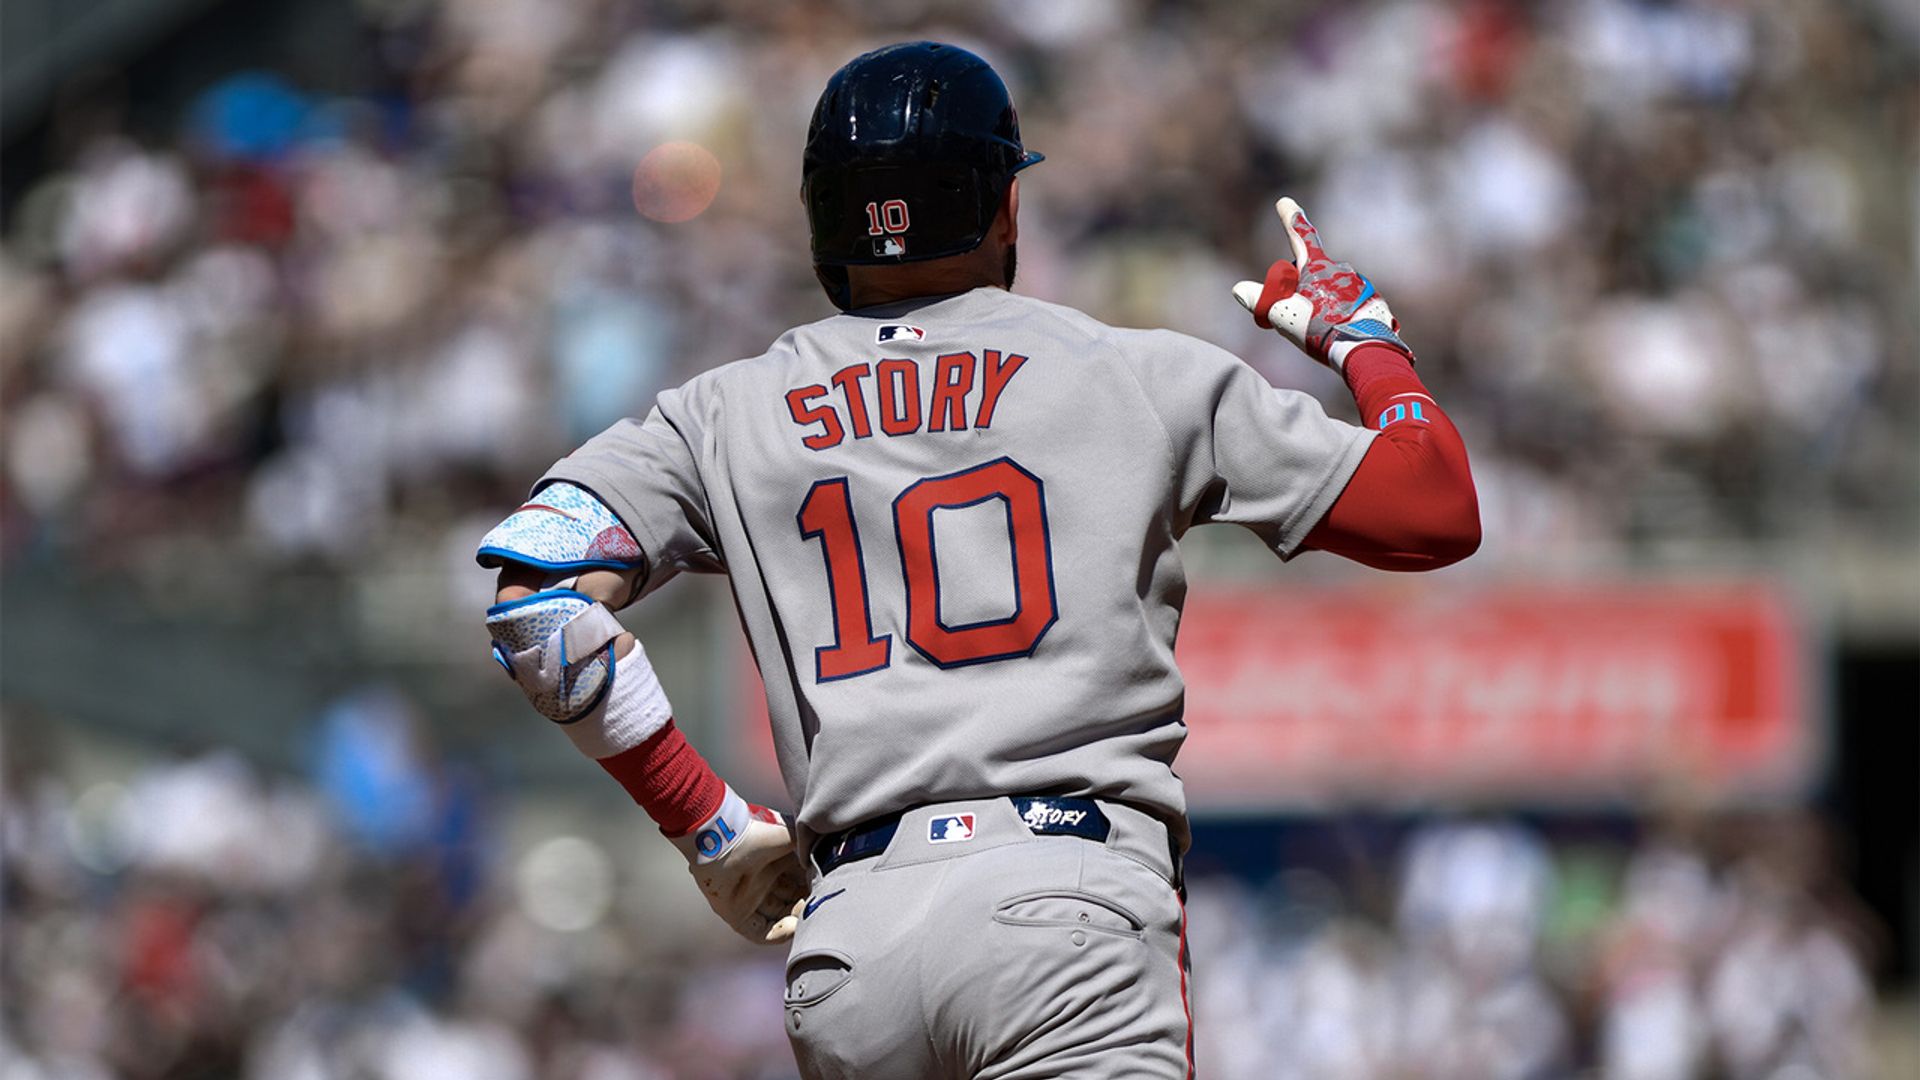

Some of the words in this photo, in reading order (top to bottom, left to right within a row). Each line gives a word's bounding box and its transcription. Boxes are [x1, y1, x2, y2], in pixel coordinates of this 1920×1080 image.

[866, 199, 910, 235] 10
[785, 349, 1028, 451] STORY
[797, 456, 1059, 684] 10
[1023, 802, 1087, 829] STORY
[695, 816, 736, 858] 10
